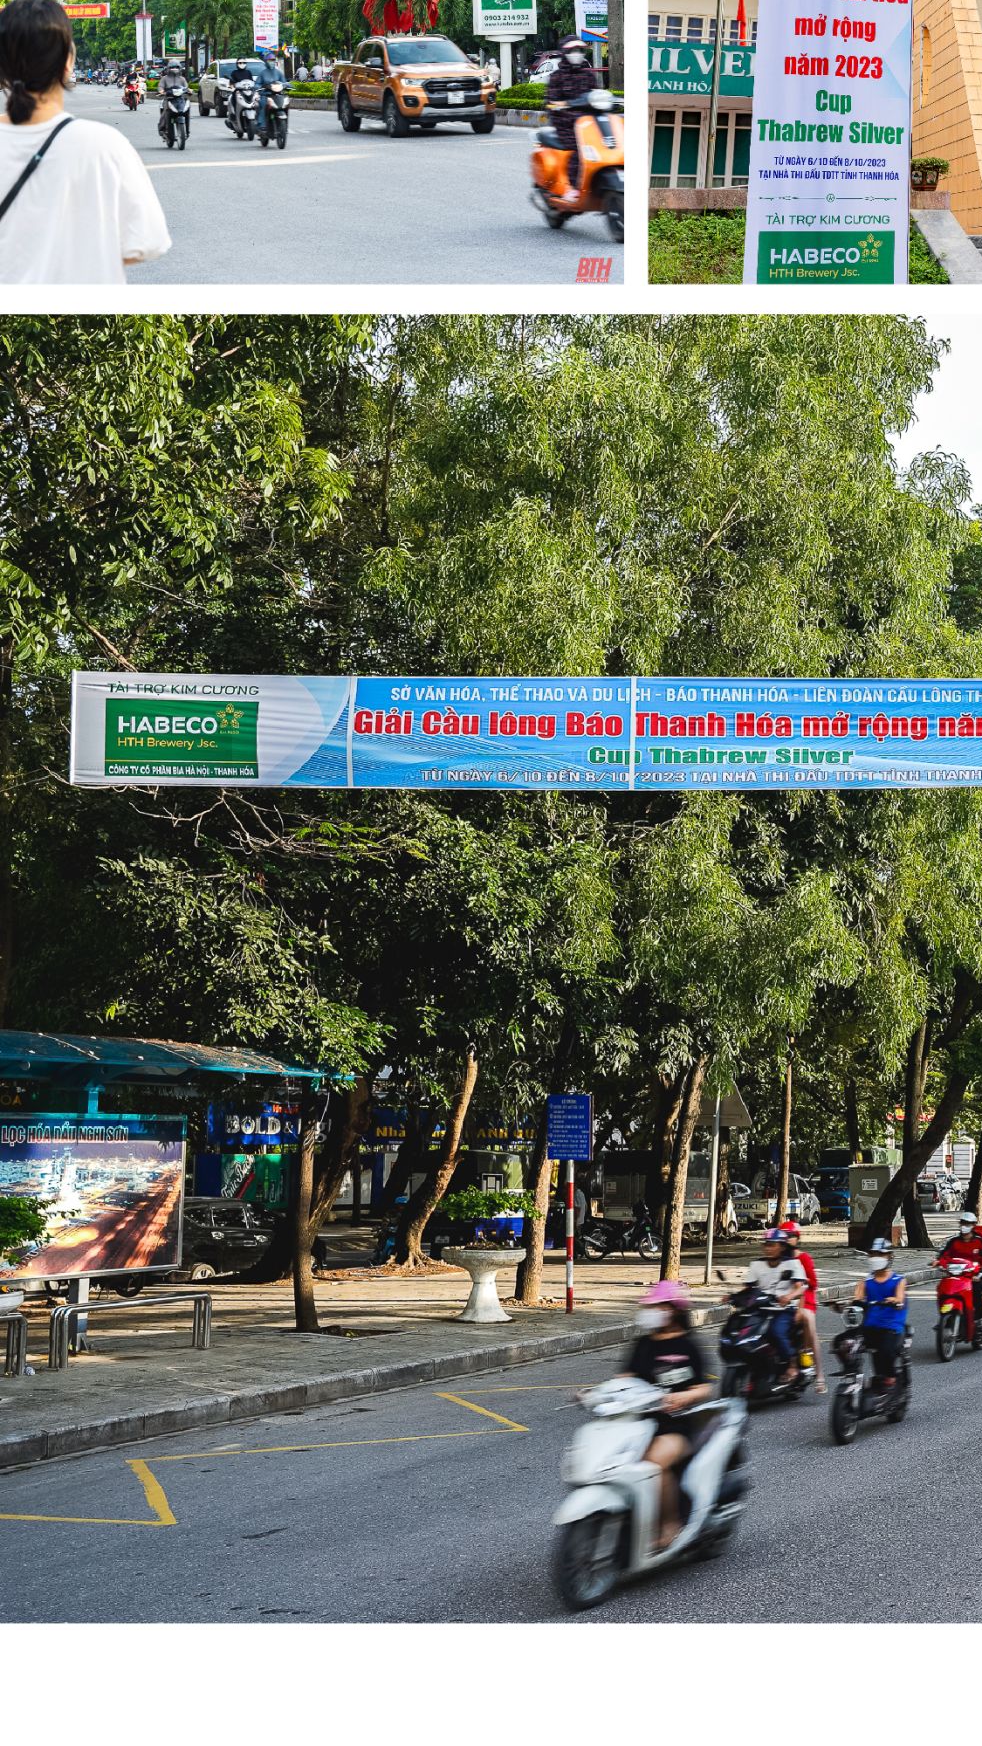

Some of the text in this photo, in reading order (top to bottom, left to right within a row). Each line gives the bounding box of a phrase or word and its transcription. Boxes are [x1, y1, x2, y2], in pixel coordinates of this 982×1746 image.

[795, 14, 877, 42] mở rộng
[785, 53, 883, 79] năm 2023
[816, 90, 852, 115] Cup
[758, 119, 904, 145] Thabrew Silver
[766, 213, 890, 227] TÀI TRỢ KIM CƯƠNG
[771, 248, 860, 265] HABECO
[118, 716, 217, 734] HABECO
[354, 707, 413, 736] Giải
[422, 707, 480, 736] Cầu
[489, 711, 557, 739] lông
[565, 712, 624, 737] Báo
[635, 711, 726, 738] Thanh
[743, 712, 793, 738] Hóa
[803, 711, 850, 738] mở
[857, 712, 928, 741] rộng
[589, 746, 854, 766] Cup Thabrew Silver
[78, 1126, 105, 1143] NGHI
[226, 1115, 281, 1135] BOLD
